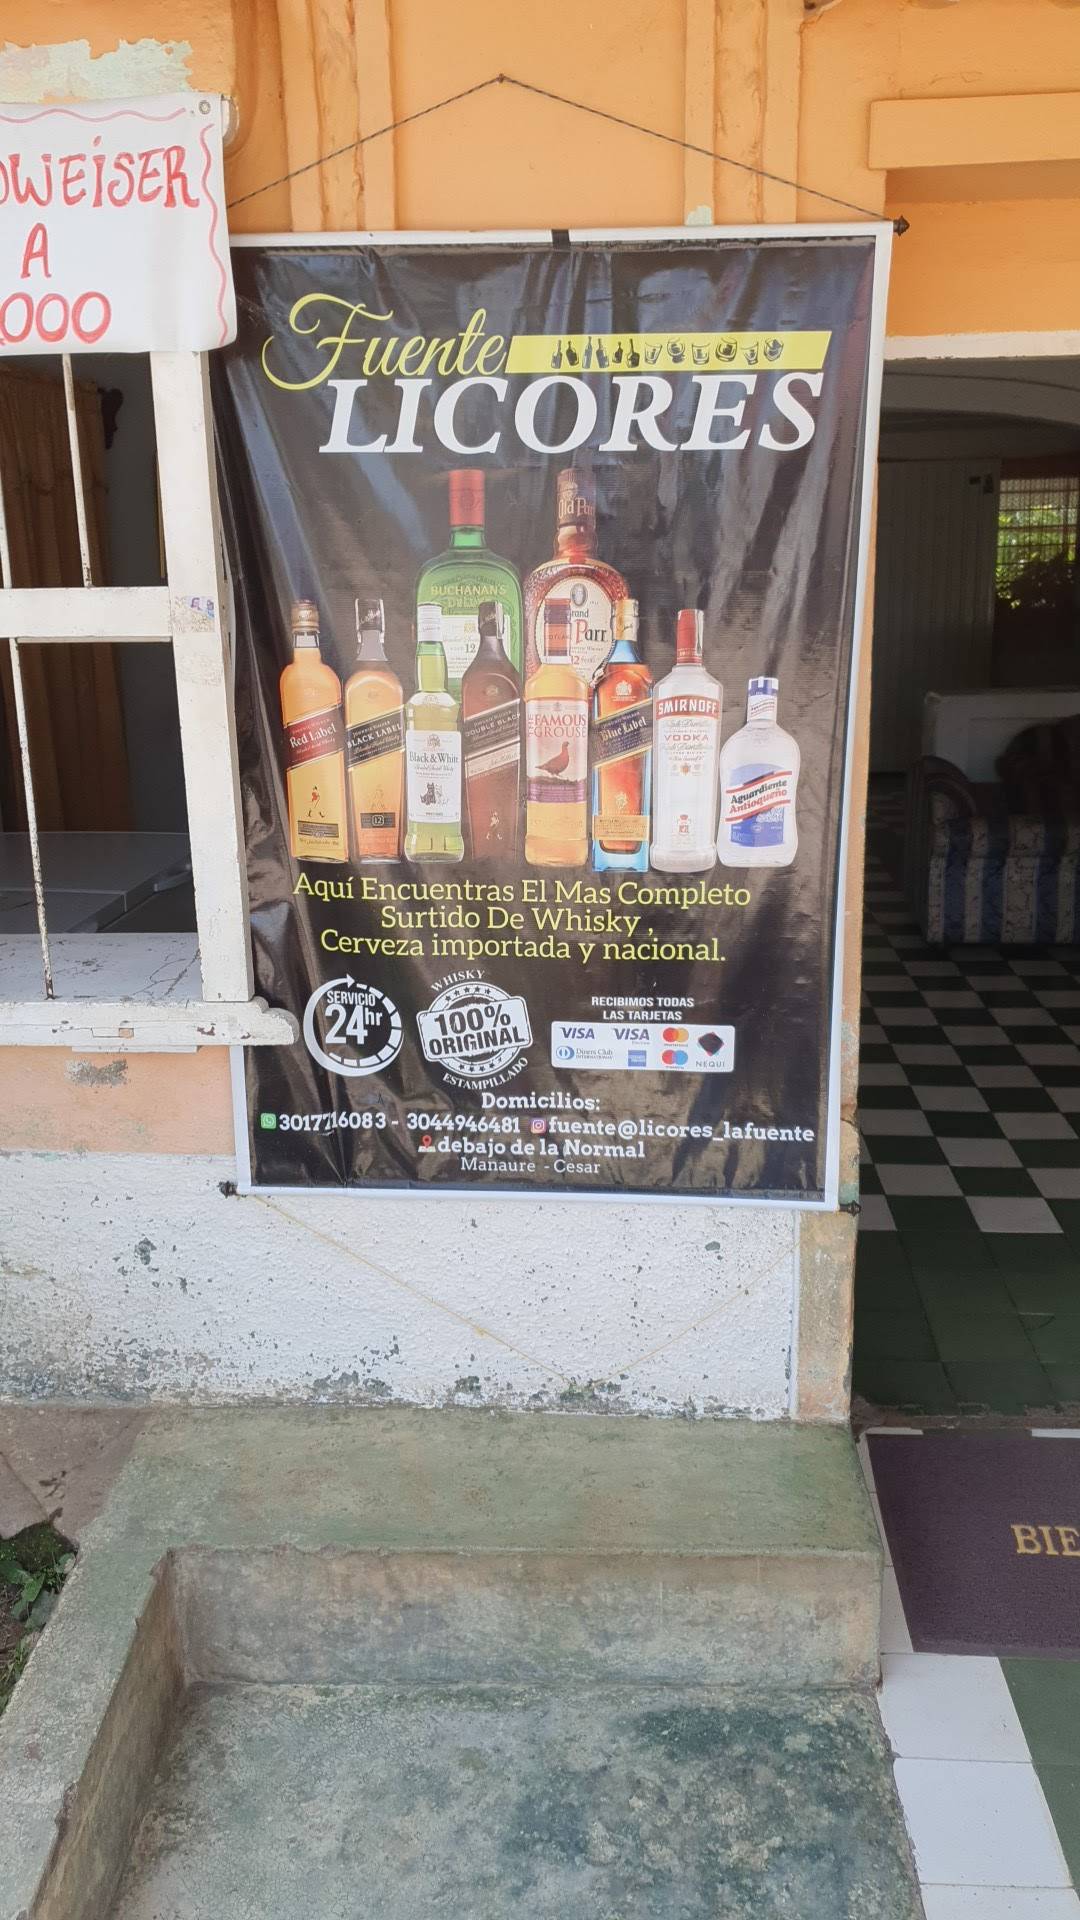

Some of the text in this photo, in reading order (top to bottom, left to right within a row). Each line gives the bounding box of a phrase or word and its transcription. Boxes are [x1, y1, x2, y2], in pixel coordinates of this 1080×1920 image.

[20, 222, 51, 279] A
[262, 293, 509, 391] Fuente
[319, 372, 824, 455] LICORES
[558, 498, 575, 519] Old
[431, 584, 506, 596] BUCHANAN'S
[571, 609, 589, 618] rand
[575, 619, 607, 645] Parr
[465, 643, 476, 653] 12
[658, 698, 718, 715] SMIRNOFF
[534, 713, 587, 726] FAMOUS
[600, 727, 622, 741] Blue
[622, 716, 647, 734] Label
[289, 731, 308, 749] Red
[308, 722, 337, 744] Label
[346, 732, 375, 749] BLACK
[376, 723, 402, 738] LABEL
[534, 726, 587, 738] GROUSE
[729, 788, 788, 814] Antioqueño
[730, 779, 788, 805] Aguardiente
[373, 816, 383, 825] 12
[292, 872, 751, 909] Aquí Encuentras El Mas Completo
[381, 905, 480, 929] Surtido
[487, 906, 524, 930] De
[320, 928, 726, 964] Cerveza importada y nacional.
[430, 968, 486, 993] WHISKY
[326, 990, 376, 1007] SERVICIO
[591, 996, 695, 1008] RECIBIMOS TODAS
[434, 1004, 511, 1037] 100%
[603, 1010, 682, 1021] LAS TARJETAS
[428, 1025, 526, 1057] ORIGINAL
[560, 1027, 595, 1039] VISA
[612, 1027, 650, 1041] VISA
[442, 1057, 529, 1090] ESTAMPILLADO
[695, 1060, 726, 1068] NEQUI
[481, 1091, 600, 1112] Domicilios:
[279, 1111, 387, 1132] 3017716083
[406, 1112, 521, 1134] 3044946481
[548, 1116, 816, 1142] fuente@licores_lafuente
[438, 1136, 646, 1158] debajo de la Normal
[460, 1156, 536, 1172] Manaure
[553, 1160, 600, 1174] Cesar
